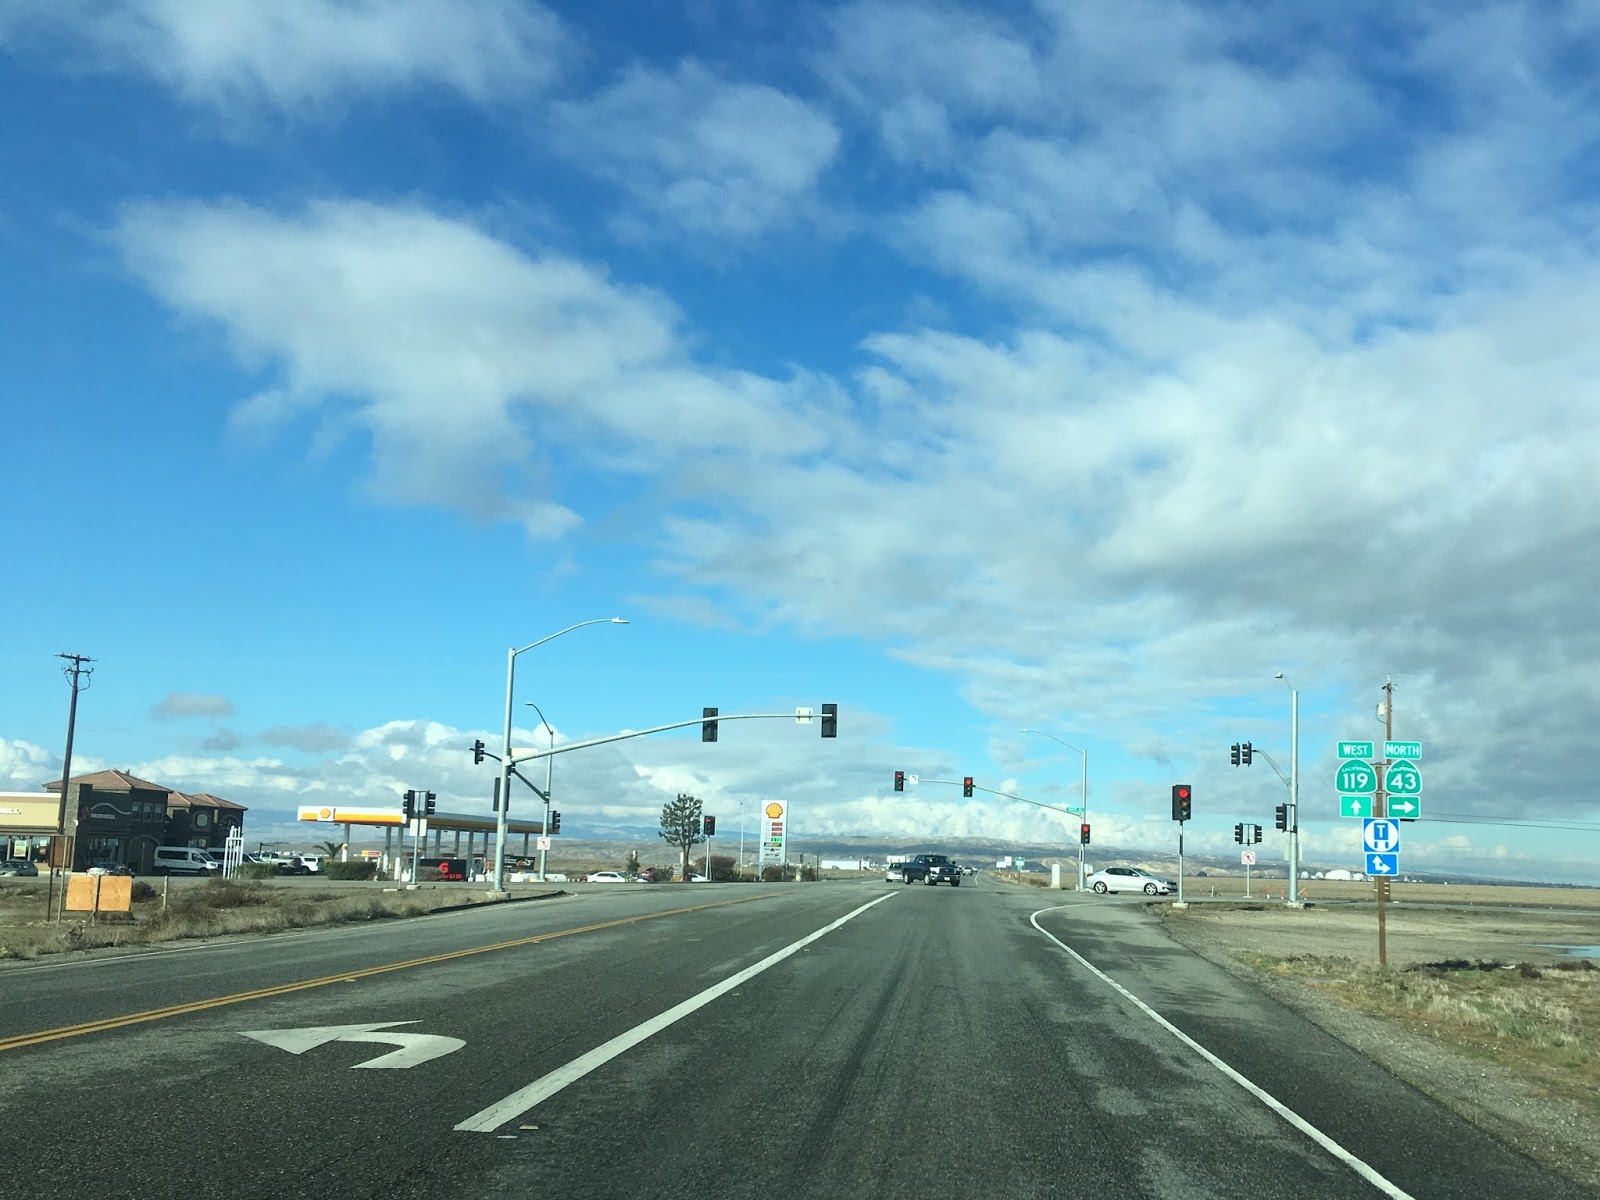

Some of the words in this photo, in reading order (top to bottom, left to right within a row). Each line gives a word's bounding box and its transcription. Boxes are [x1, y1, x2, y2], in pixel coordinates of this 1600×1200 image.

[1342, 744, 1368, 756] WEST
[1386, 744, 1420, 756] NORTH
[1341, 765, 1371, 773] CALIFORNIA
[1389, 766, 1418, 774] CALIFORNIA
[1342, 772, 1368, 789] 119
[1390, 773, 1417, 790] 43
[1376, 824, 1386, 838] T
